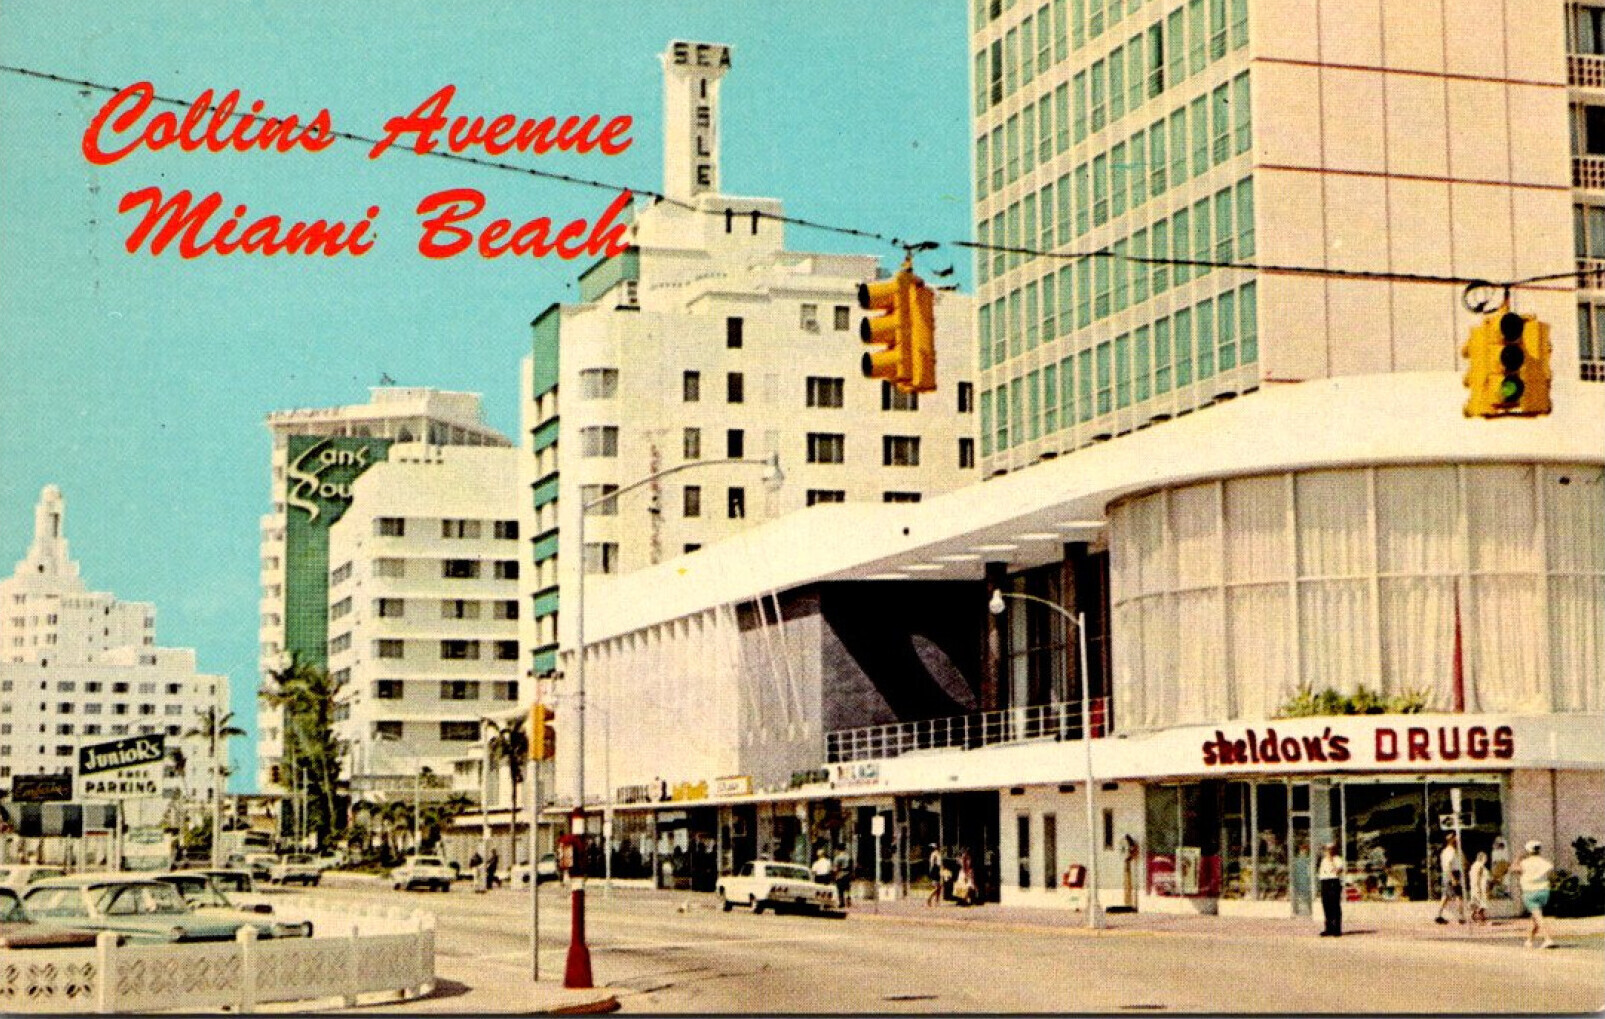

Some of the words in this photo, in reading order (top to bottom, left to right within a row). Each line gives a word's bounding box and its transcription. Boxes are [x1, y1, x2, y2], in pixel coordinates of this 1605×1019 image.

[673, 41, 732, 69] SEA
[697, 78, 711, 186] ISLE
[1202, 727, 1350, 766] sheldon's
[1374, 725, 1515, 762] DRUGS
[85, 780, 157, 793] PARKING
